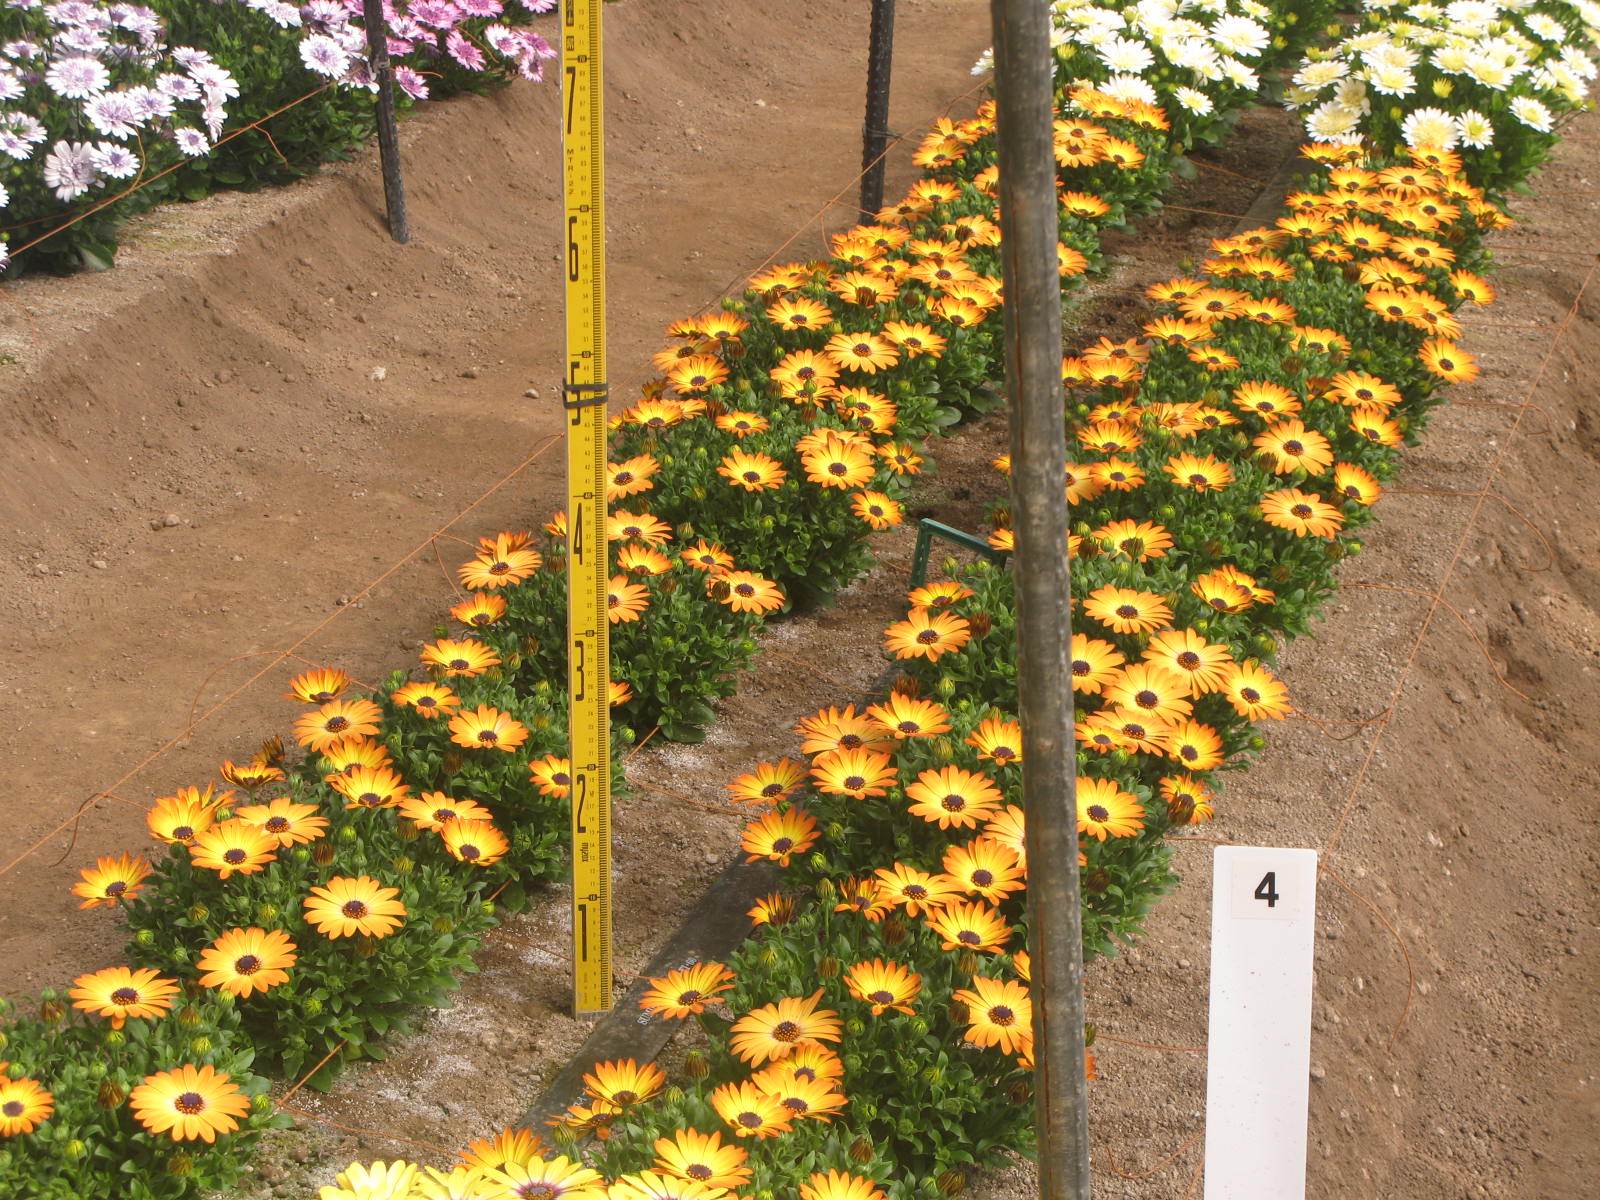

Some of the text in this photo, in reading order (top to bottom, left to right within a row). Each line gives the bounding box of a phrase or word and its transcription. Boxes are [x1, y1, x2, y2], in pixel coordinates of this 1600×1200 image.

[566, 66, 576, 134] 7
[568, 215, 578, 282] 6
[571, 361, 581, 426] 5
[573, 502, 583, 566] 4
[575, 640, 584, 702] 3
[577, 773, 586, 834] 2
[1254, 871, 1280, 908] 4
[578, 904, 587, 962] 1
